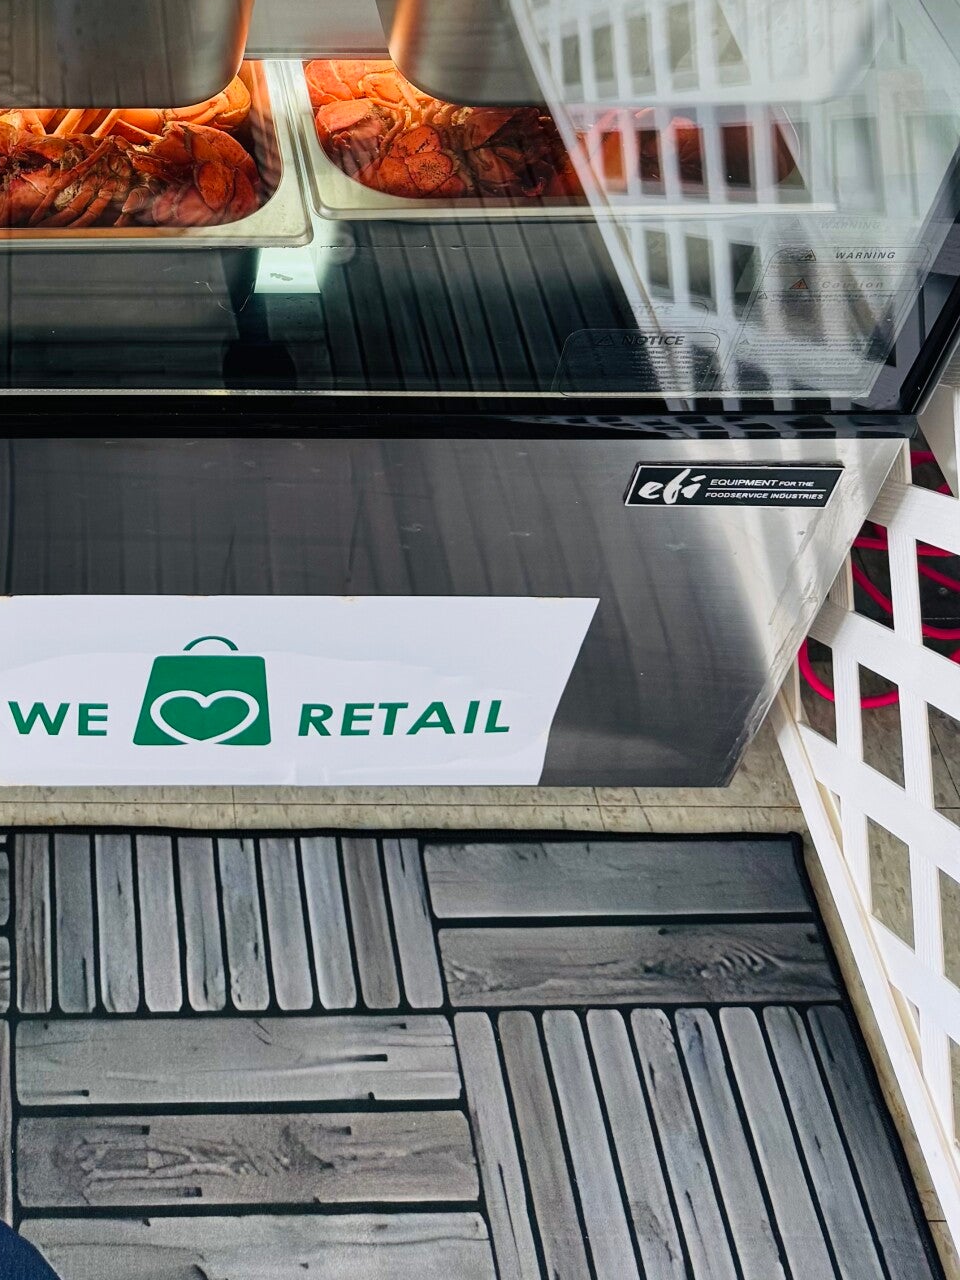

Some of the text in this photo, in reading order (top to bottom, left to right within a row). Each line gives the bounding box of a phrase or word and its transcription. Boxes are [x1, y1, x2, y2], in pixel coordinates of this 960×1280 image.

[834, 251, 896, 259] WARNING
[621, 335, 685, 345] NOTICE
[710, 478, 779, 487] EQUIPMENT
[7, 699, 511, 738] WE RETAIL
